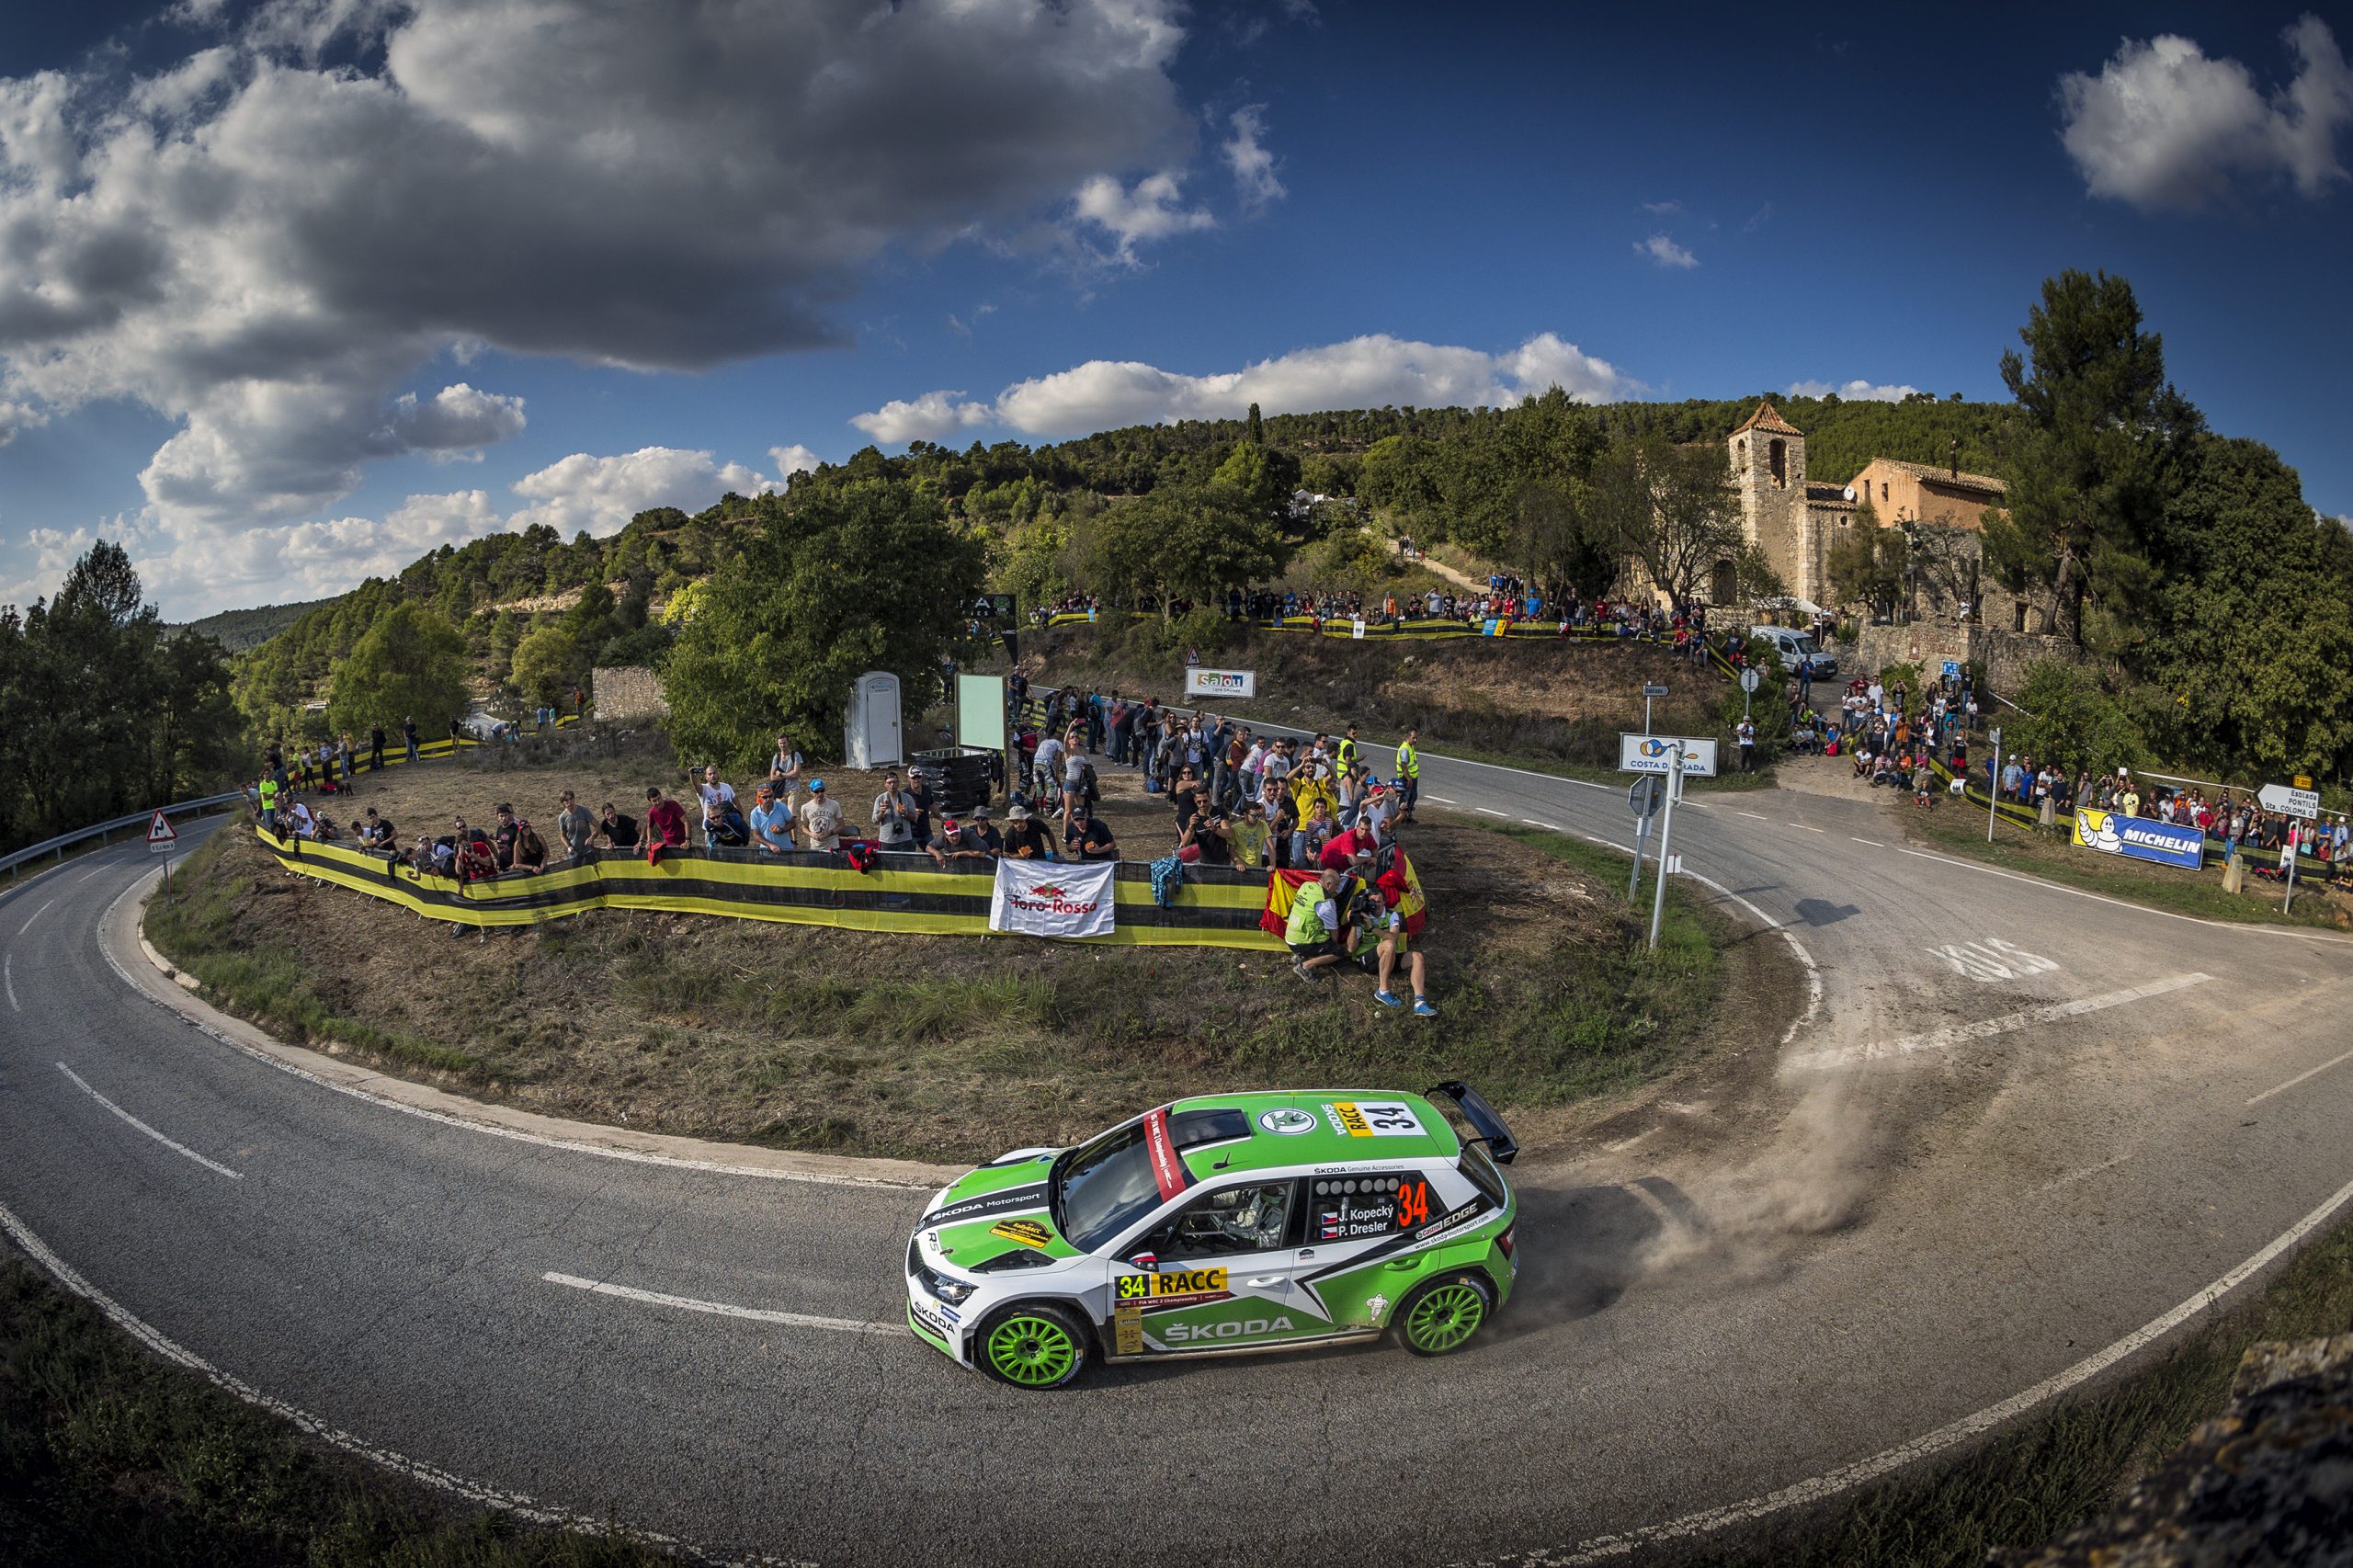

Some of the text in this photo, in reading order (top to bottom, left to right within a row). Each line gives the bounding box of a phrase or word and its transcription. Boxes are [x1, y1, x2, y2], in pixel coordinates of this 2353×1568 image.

[1199, 673, 1243, 687] Salou
[1631, 760, 1706, 772] COSTA DRADA
[2288, 798, 2316, 809] PONTILS
[2290, 790, 2317, 801] Esblada
[2265, 801, 2278, 811] Sta.
[2279, 804, 2307, 816] COLOMA
[2122, 829, 2200, 854] MICHELIN
[1012, 894, 1097, 915] Toro Rosso
[1321, 1103, 1348, 1136] ŠKODA
[1338, 1107, 1369, 1131] RACC
[1363, 1107, 1416, 1130] 34
[1314, 1166, 1347, 1175] ŠKODA
[931, 1193, 1040, 1221] ŠKODA Motorsport
[1338, 1204, 1394, 1221] J. Kopecký
[1398, 1181, 1428, 1227] 34
[1443, 1202, 1478, 1228] EDGE
[1338, 1221, 1388, 1236] P. Dresler
[927, 1233, 939, 1252] R5
[1120, 1269, 1220, 1298] 34 RACC
[915, 1301, 956, 1335] ŠKODA
[1165, 1316, 1294, 1342] ŠKODA
